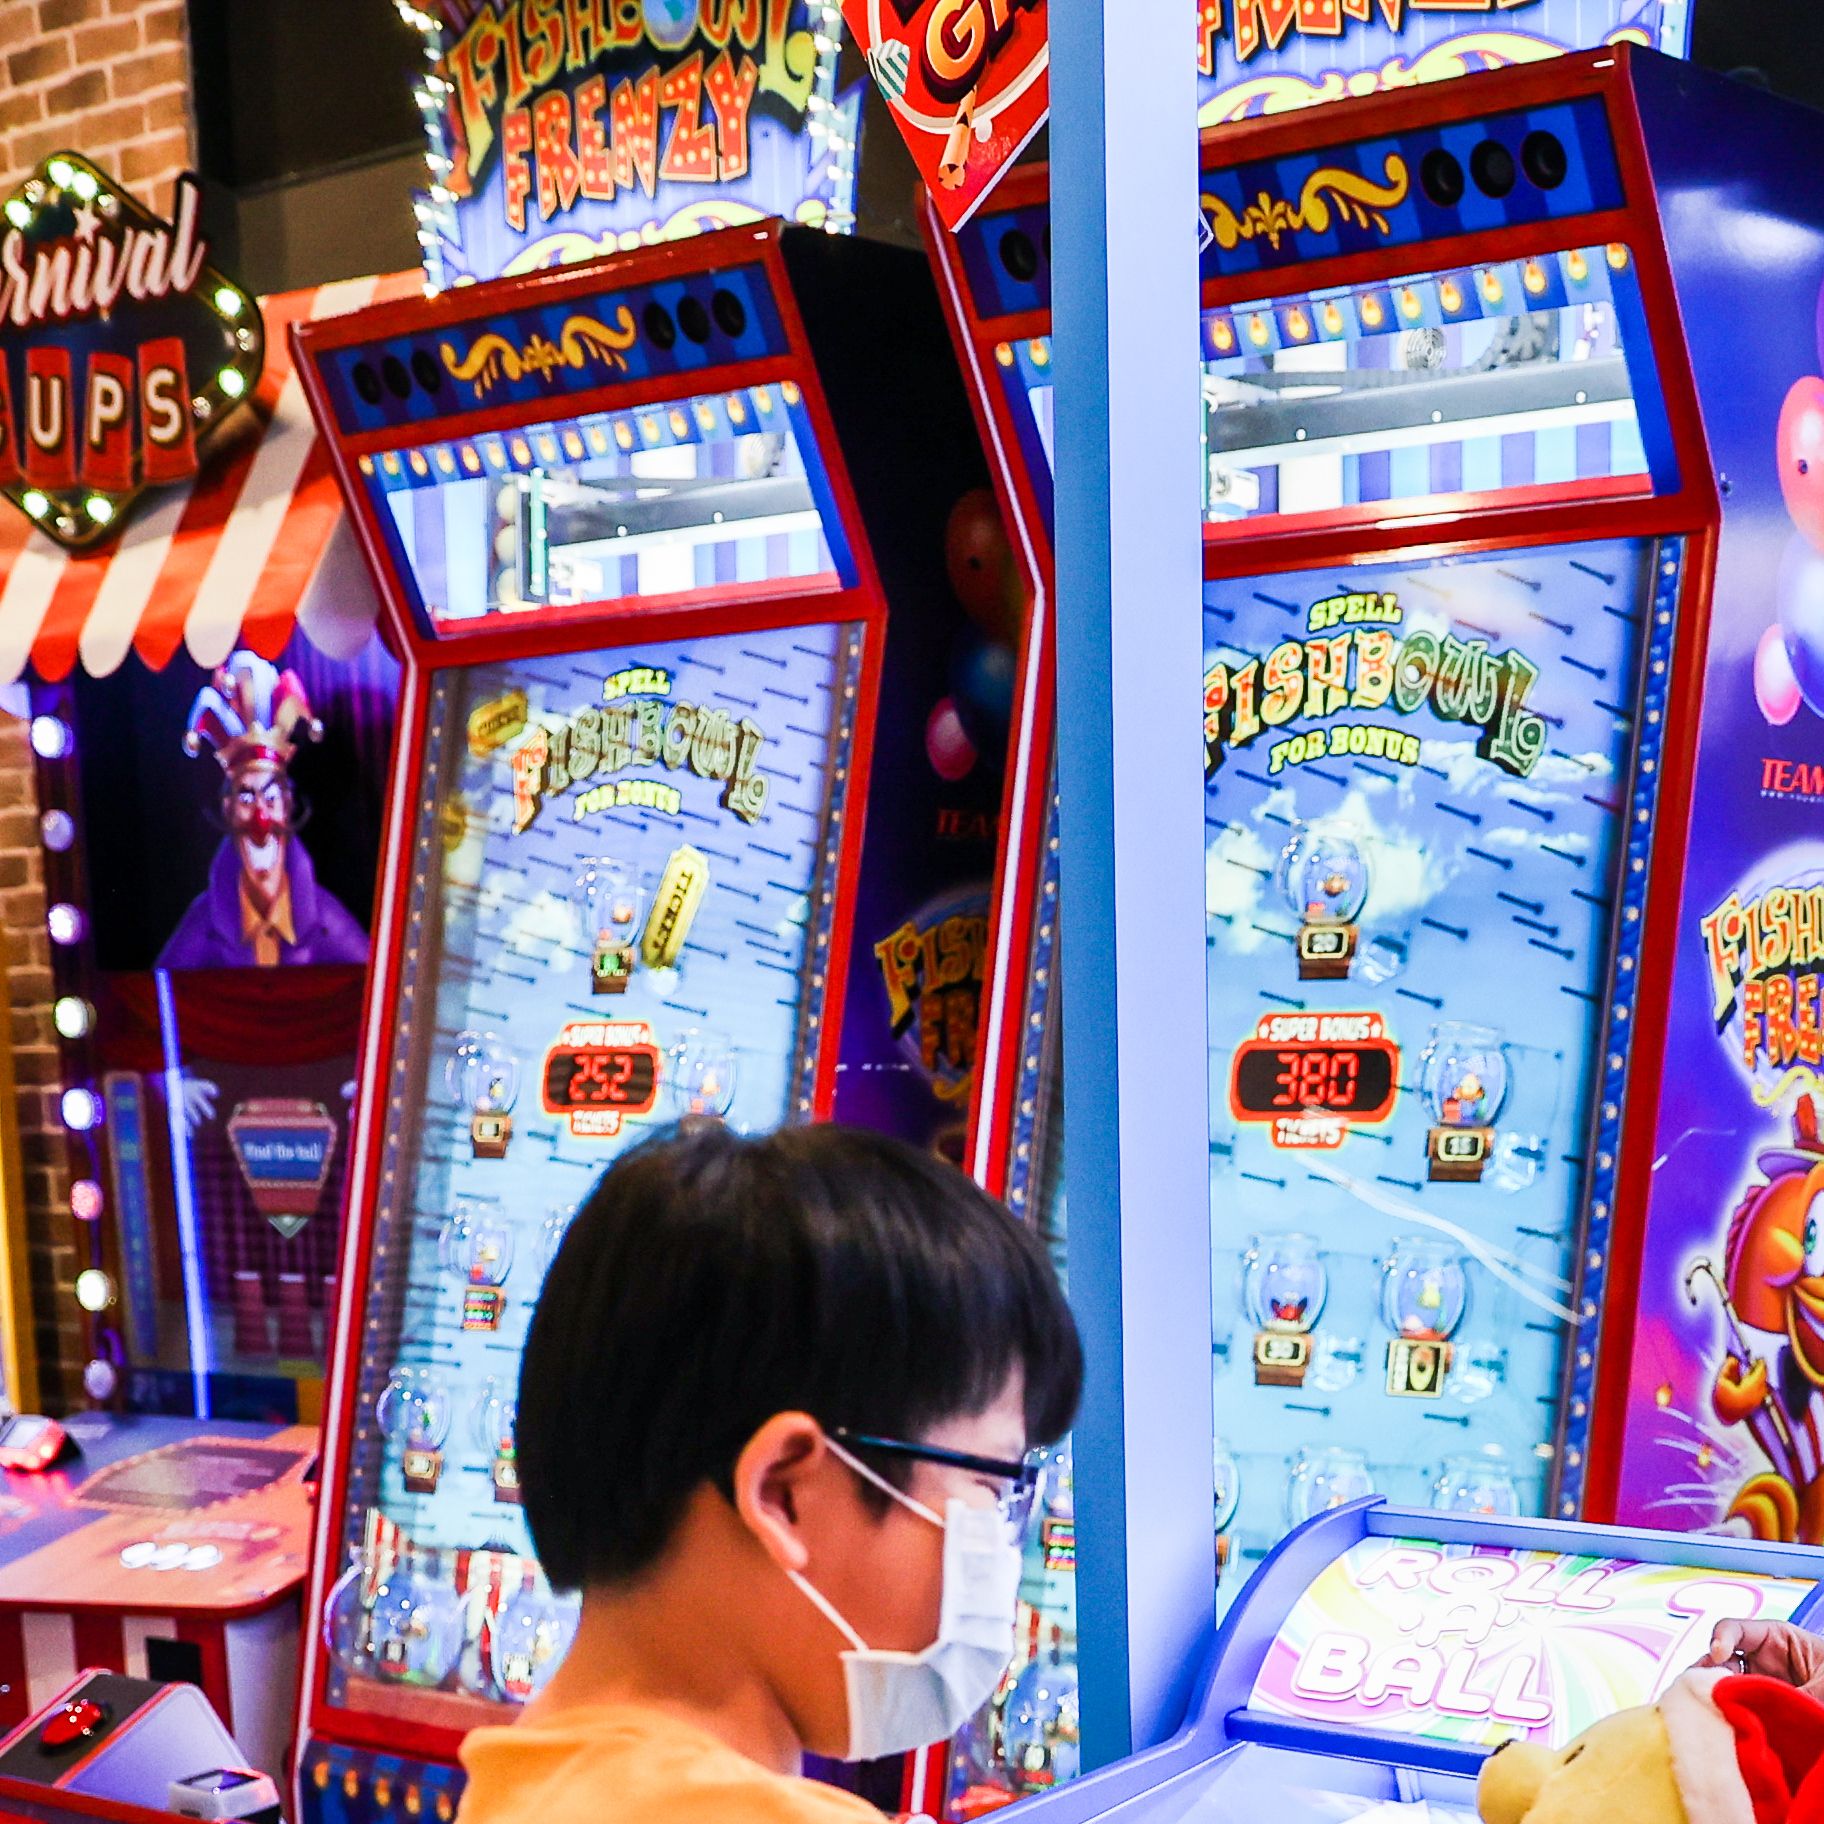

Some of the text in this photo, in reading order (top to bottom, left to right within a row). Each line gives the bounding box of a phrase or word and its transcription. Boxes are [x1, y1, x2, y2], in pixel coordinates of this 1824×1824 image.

[502, 50, 759, 232] FRENZY
[0, 181, 206, 326] rnival
[0, 368, 182, 448] UPS
[1308, 593, 1402, 632] SPELL
[512, 700, 769, 836] FISHBOWL
[1269, 726, 1420, 774] FOR BONUS
[1269, 1016, 1318, 1042] SUPER
[568, 1054, 634, 1101] 252
[1272, 1052, 1359, 1106] 380
[1356, 1548, 1615, 1610] ROLL
[1291, 1633, 1553, 1727] BALL
